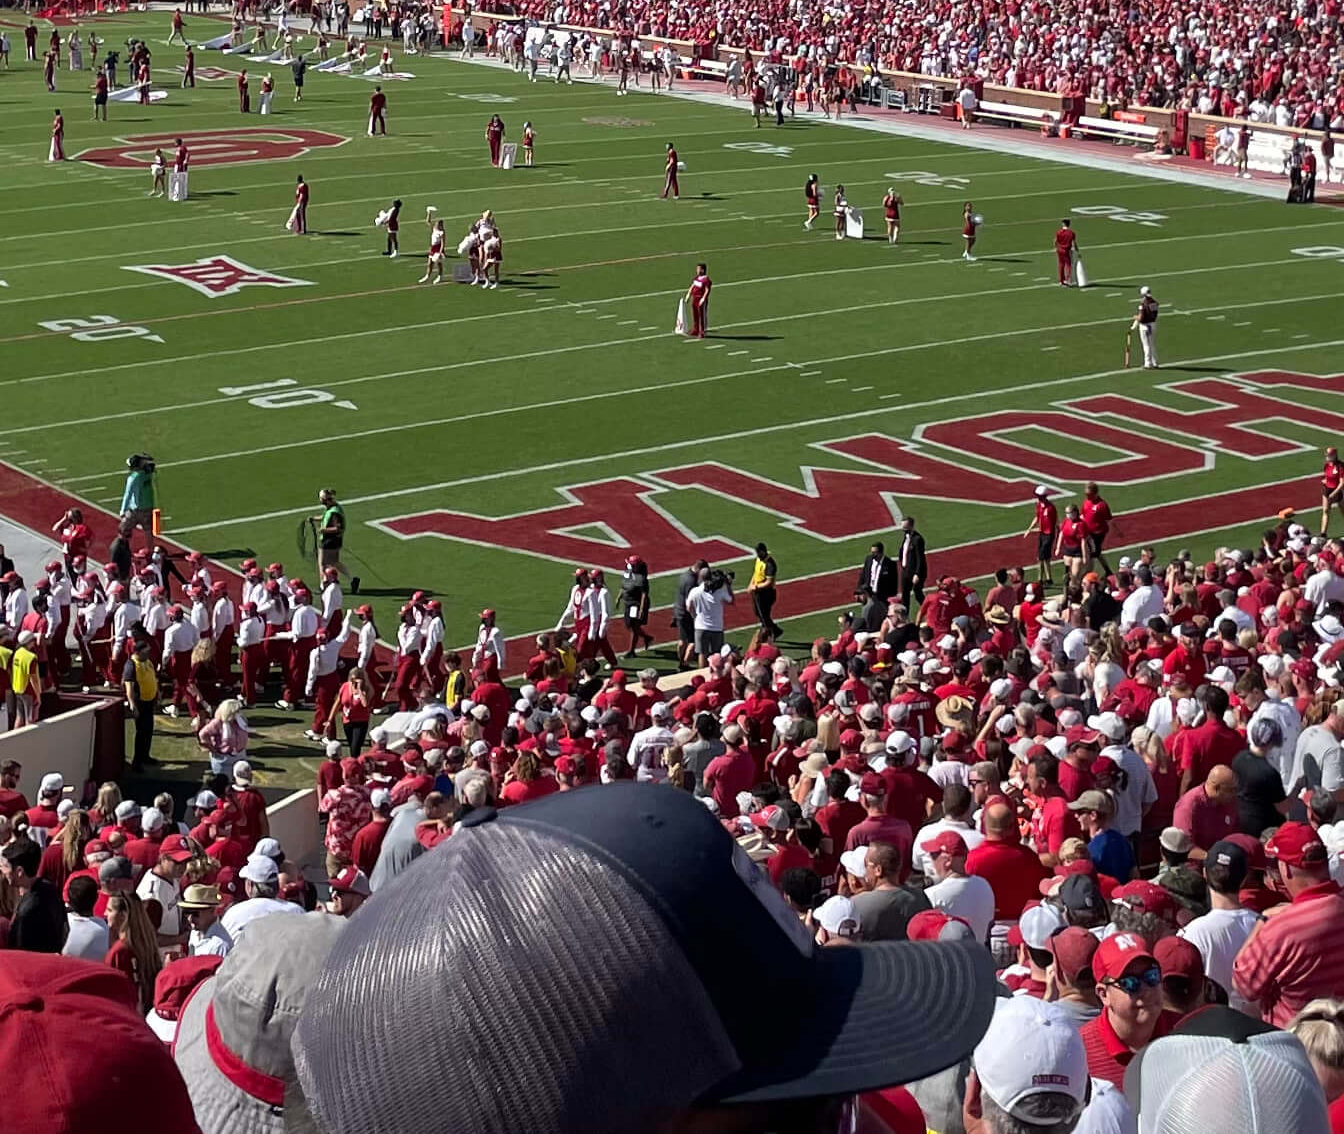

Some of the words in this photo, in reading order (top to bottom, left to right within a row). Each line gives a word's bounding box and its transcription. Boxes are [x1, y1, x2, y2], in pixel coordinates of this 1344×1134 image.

[37, 314, 150, 342] 20
[217, 377, 337, 408] 10
[1114, 932, 1137, 951] N
